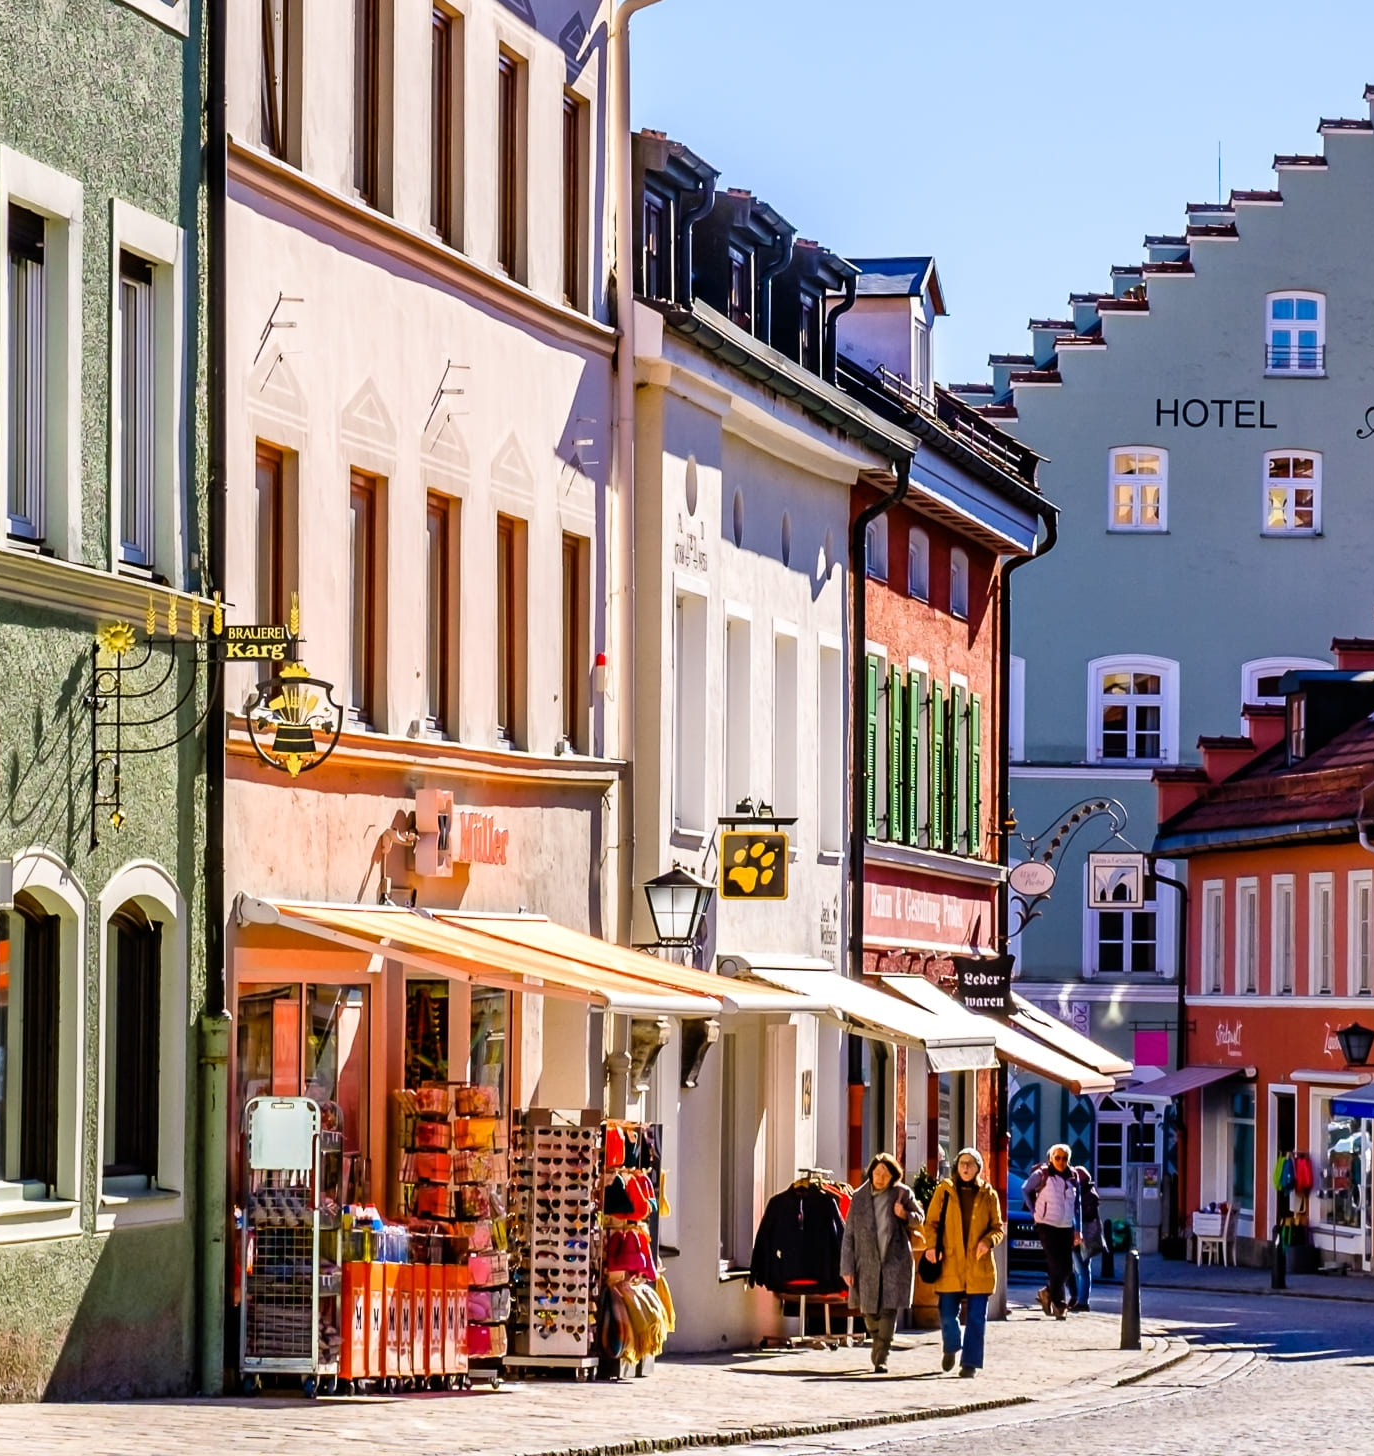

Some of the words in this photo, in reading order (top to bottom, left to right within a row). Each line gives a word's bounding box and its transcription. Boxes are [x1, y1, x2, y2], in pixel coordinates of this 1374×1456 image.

[1156, 398, 1277, 429] HOTEL
[228, 627, 285, 640] BRAUEREI
[226, 643, 287, 660] Karg
[459, 810, 509, 866] Müller
[870, 883, 893, 919] Raum
[895, 886, 902, 920] &
[905, 887, 941, 934] Gestaltung
[943, 894, 964, 928] Probst
[965, 996, 1004, 1007] waren
